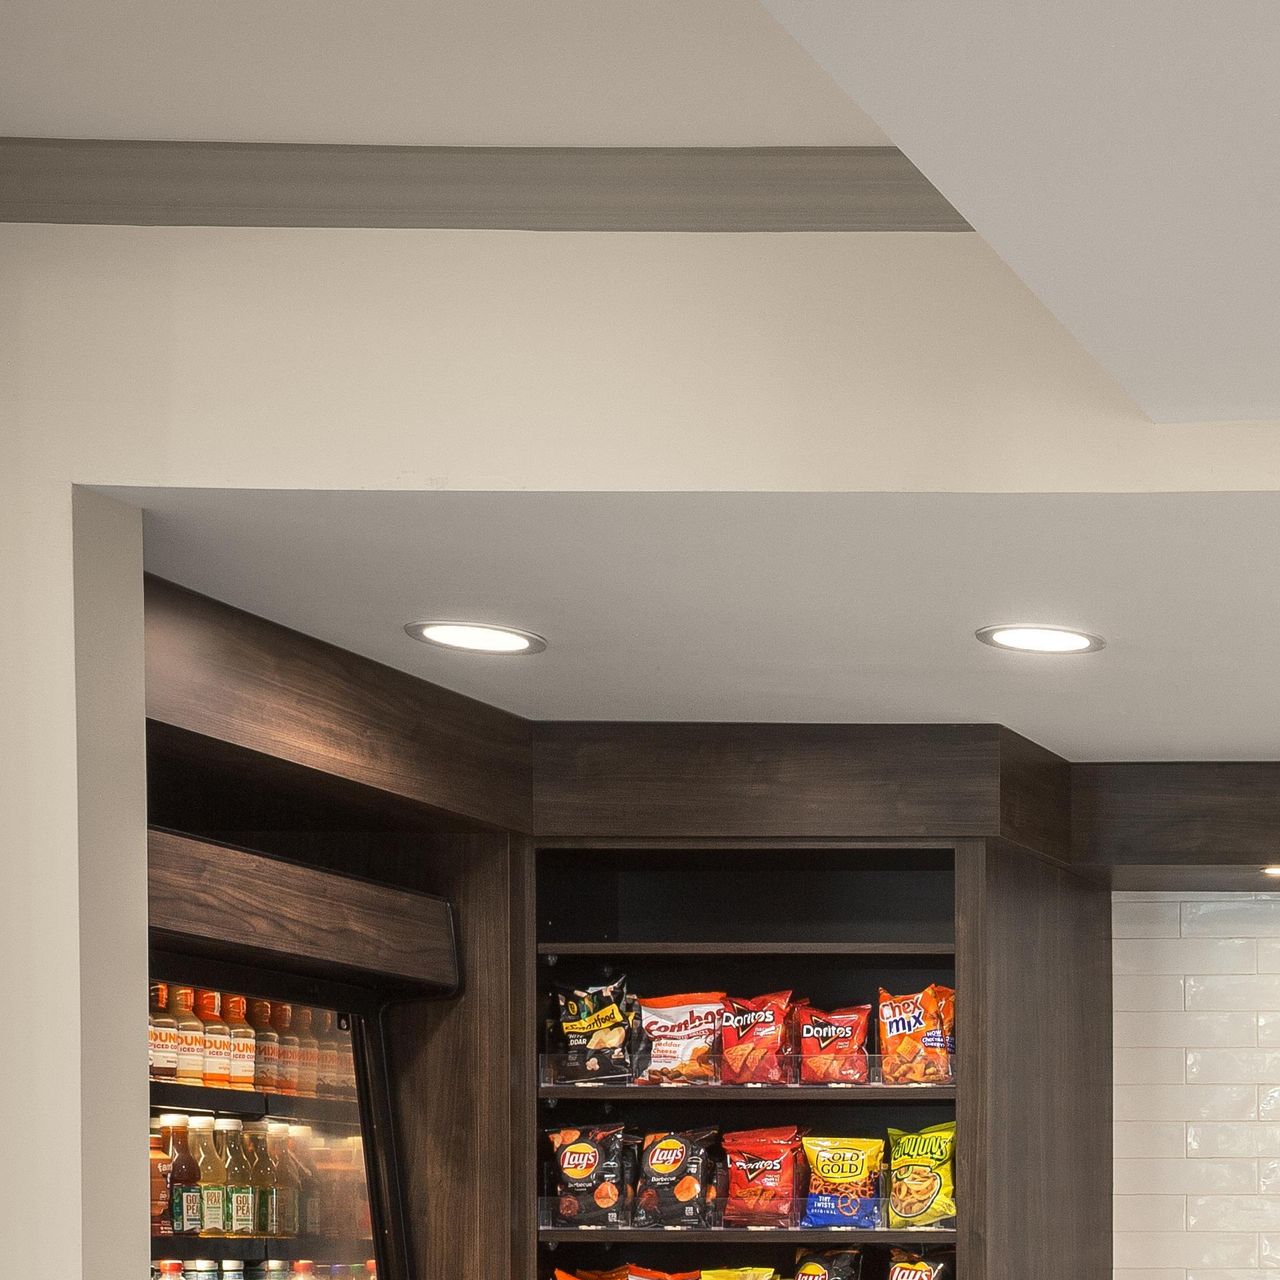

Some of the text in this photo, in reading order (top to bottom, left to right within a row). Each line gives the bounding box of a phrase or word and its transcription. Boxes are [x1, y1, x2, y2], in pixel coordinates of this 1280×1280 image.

[722, 1009, 775, 1027] Doritos
[880, 998, 922, 1021] Chex
[802, 1024, 852, 1038] Doritos
[563, 1151, 596, 1170] Lay's
[651, 1148, 684, 1166] Lay's
[820, 1163, 859, 1174] GOLD
